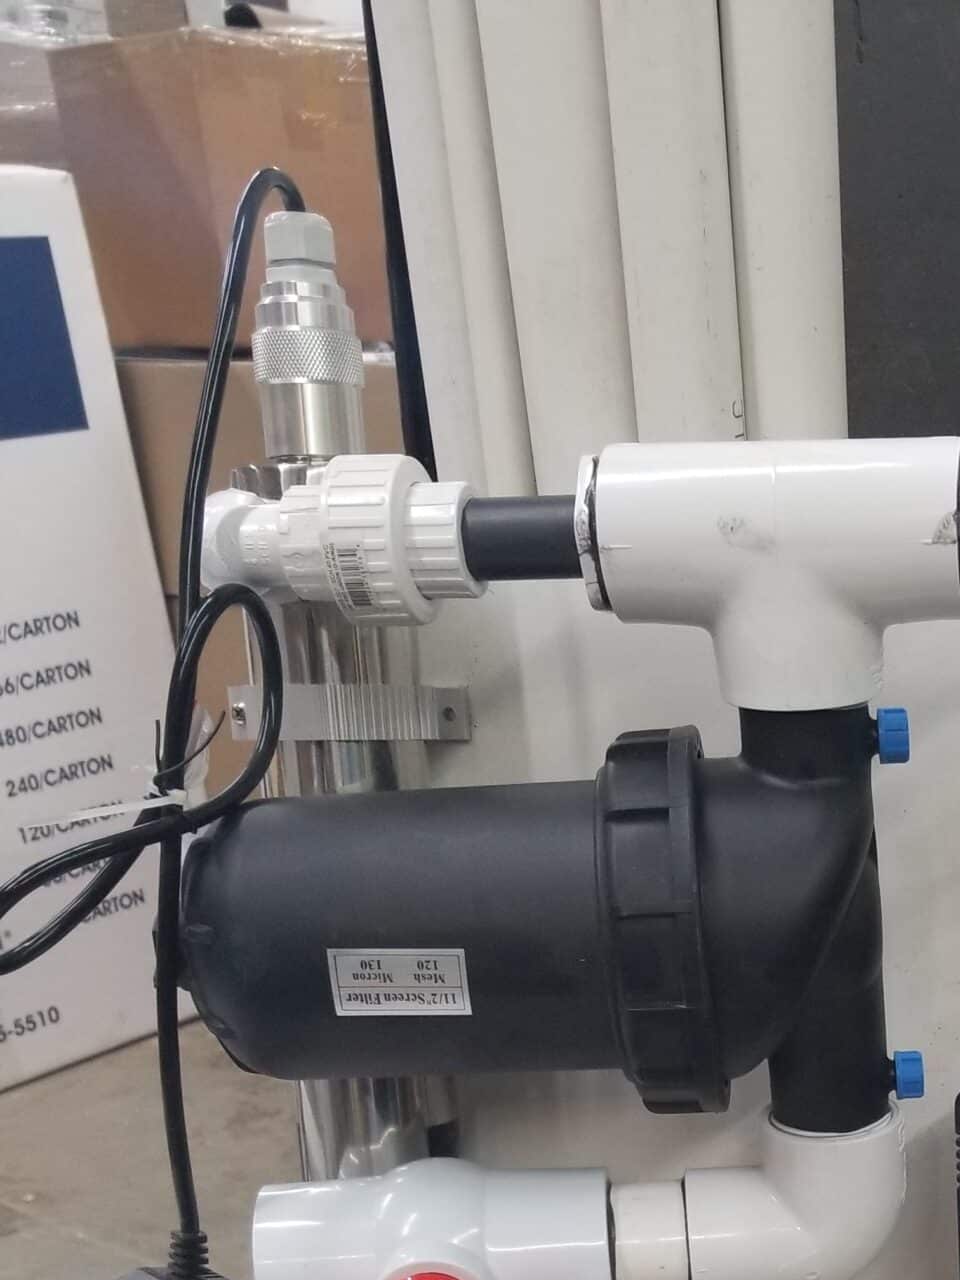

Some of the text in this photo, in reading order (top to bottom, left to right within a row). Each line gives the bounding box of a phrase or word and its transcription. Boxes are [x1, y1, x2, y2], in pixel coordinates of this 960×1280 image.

[0, 610, 80, 645] /CARTON
[5, 754, 114, 798] 240/CARTON
[80, 888, 145, 924] ARTON
[360, 959, 438, 970] 120 130
[352, 972, 447, 984] Mesh Micron
[346, 992, 382, 1005] Filter
[384, 992, 425, 1005] Screen
